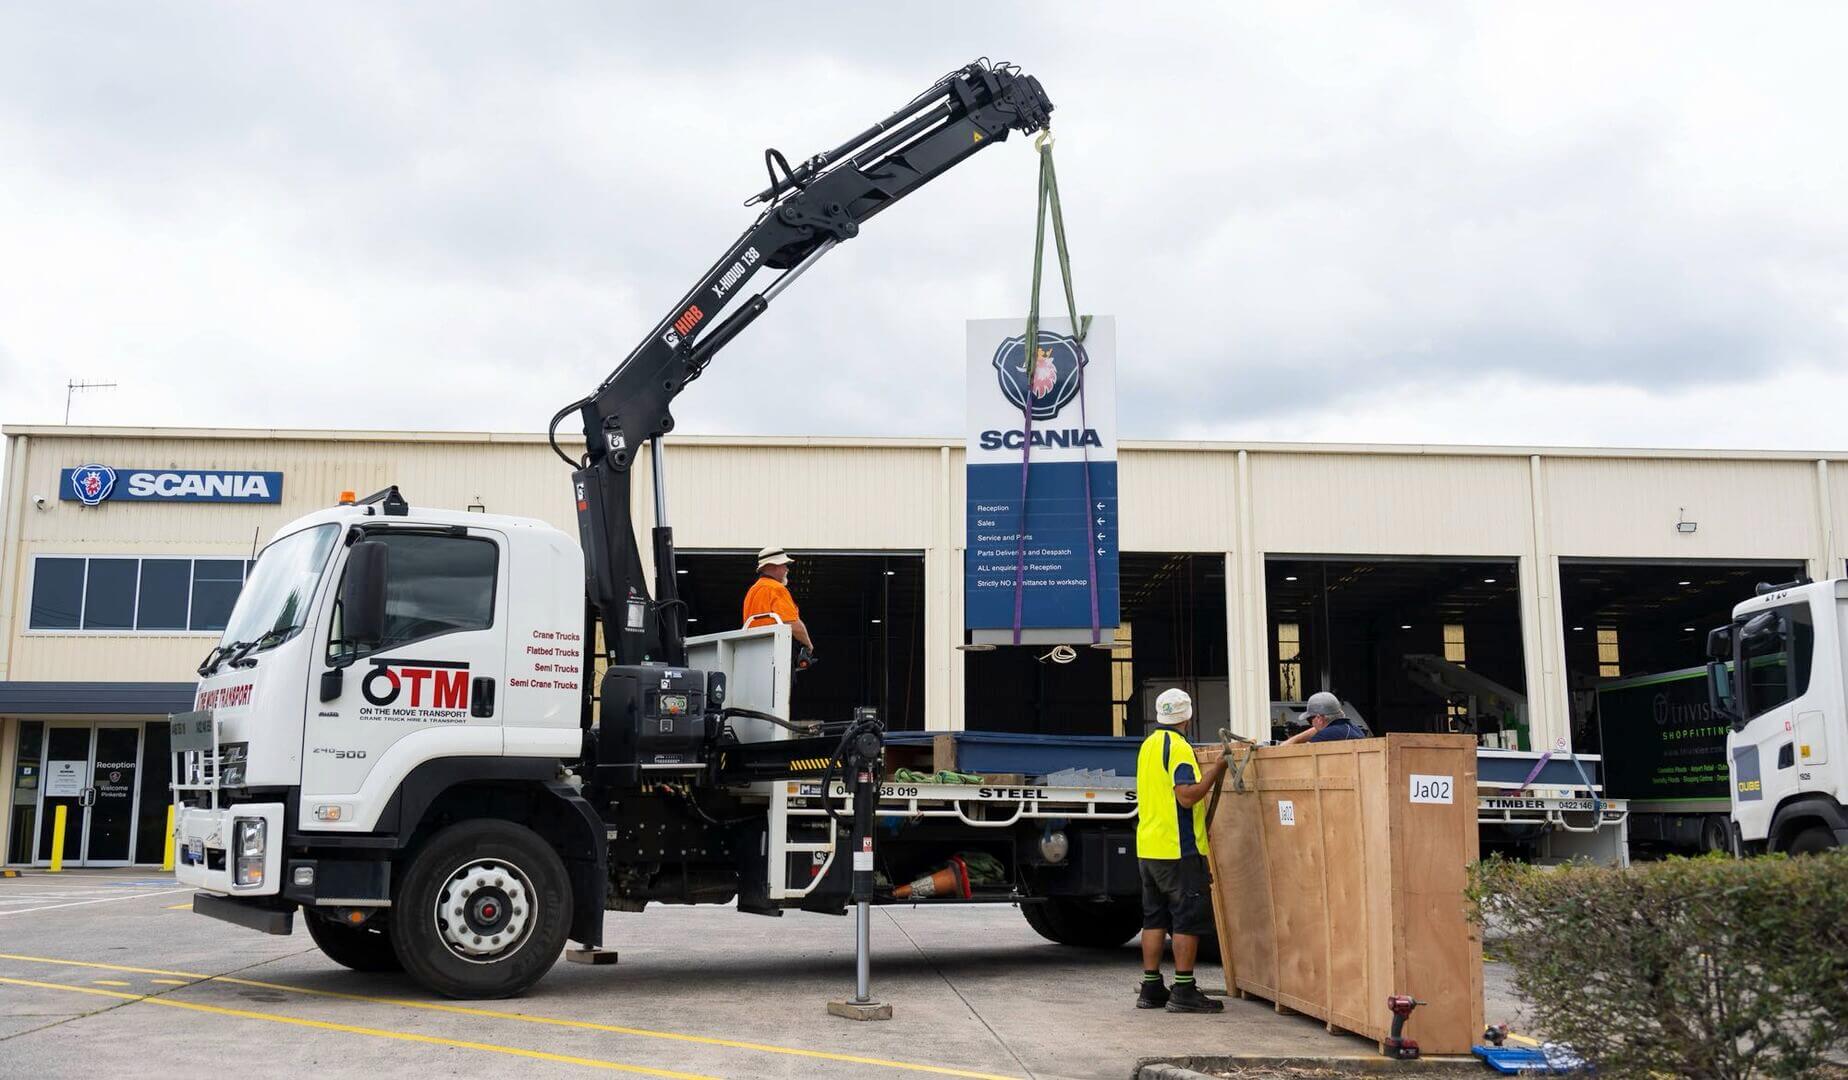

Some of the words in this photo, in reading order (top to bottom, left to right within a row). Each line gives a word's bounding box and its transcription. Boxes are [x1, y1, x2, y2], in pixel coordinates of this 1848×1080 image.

[711, 261, 746, 298] X-HIDUO
[741, 246, 760, 266] 138
[674, 304, 704, 336] HIAB
[980, 429, 1103, 450] SCANIA
[128, 472, 270, 498] SCANIA
[977, 519, 995, 527] Sales
[977, 549, 994, 557] Parts
[1041, 548, 1072, 556] Despatch
[992, 564, 1018, 572] enquirie
[1030, 563, 1062, 571] Reception
[977, 579, 999, 587] Strictly
[1056, 578, 1088, 587] workshop
[532, 630, 554, 640] Crane
[555, 631, 580, 641] Trucks
[526, 646, 553, 656] Flatbed
[555, 648, 580, 657] Trucks
[534, 663, 553, 672] Semi
[554, 664, 579, 673] Trucks
[509, 678, 529, 687] Semi
[530, 679, 552, 688] Crane
[553, 680, 578, 689] Trucks
[360, 707, 372, 715] ON
[374, 708, 390, 716] THE
[392, 708, 416, 717] MOVE
[418, 709, 467, 718] TRANSPORT
[1662, 726, 1731, 740] SHOPFITTING
[335, 750, 367, 759] 300
[96, 761, 136, 769] Reception
[880, 786, 894, 796] 58
[897, 787, 918, 797] 019
[1413, 781, 1449, 799] Ja02
[1738, 781, 1760, 792] QUBE
[979, 788, 1048, 799] STEEL
[1486, 799, 1545, 809] TIMBER
[1558, 801, 1577, 809] 0422
[1580, 801, 1593, 809] 146
